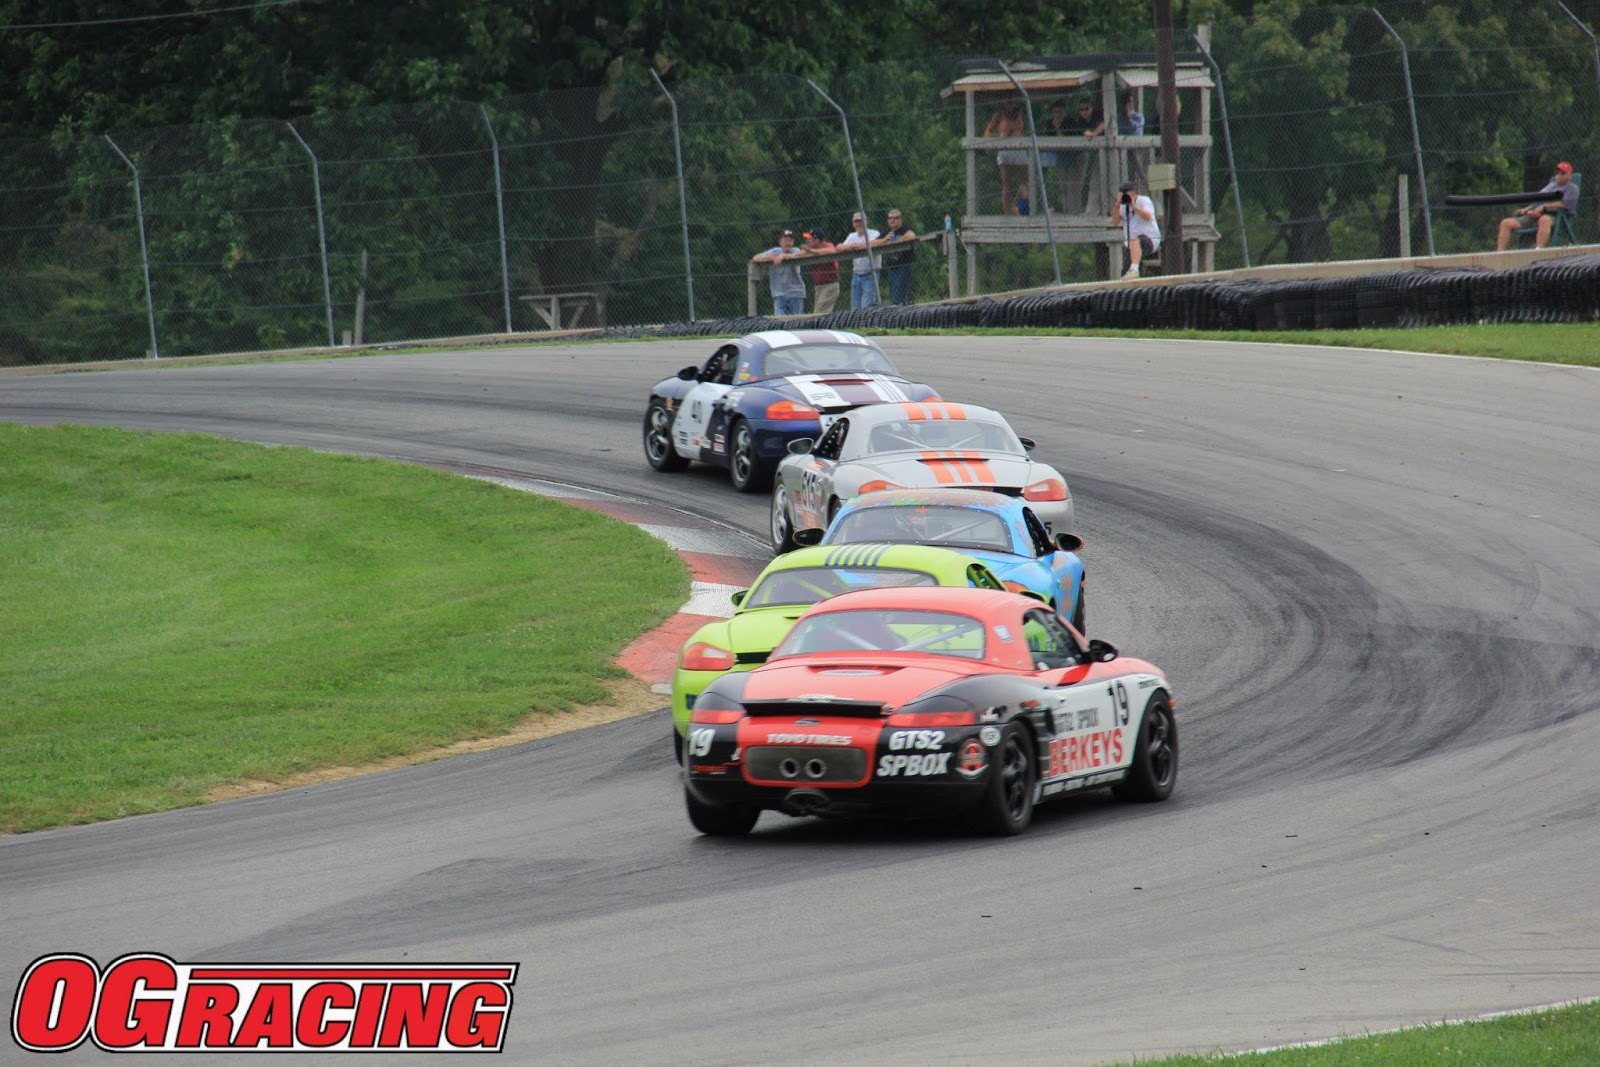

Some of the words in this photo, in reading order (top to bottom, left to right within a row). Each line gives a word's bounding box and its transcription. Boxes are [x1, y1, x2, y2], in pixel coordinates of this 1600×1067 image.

[1107, 681, 1129, 727] 19
[688, 728, 716, 757] 19
[888, 730, 945, 751] GTS2
[877, 752, 952, 778] SPBOX
